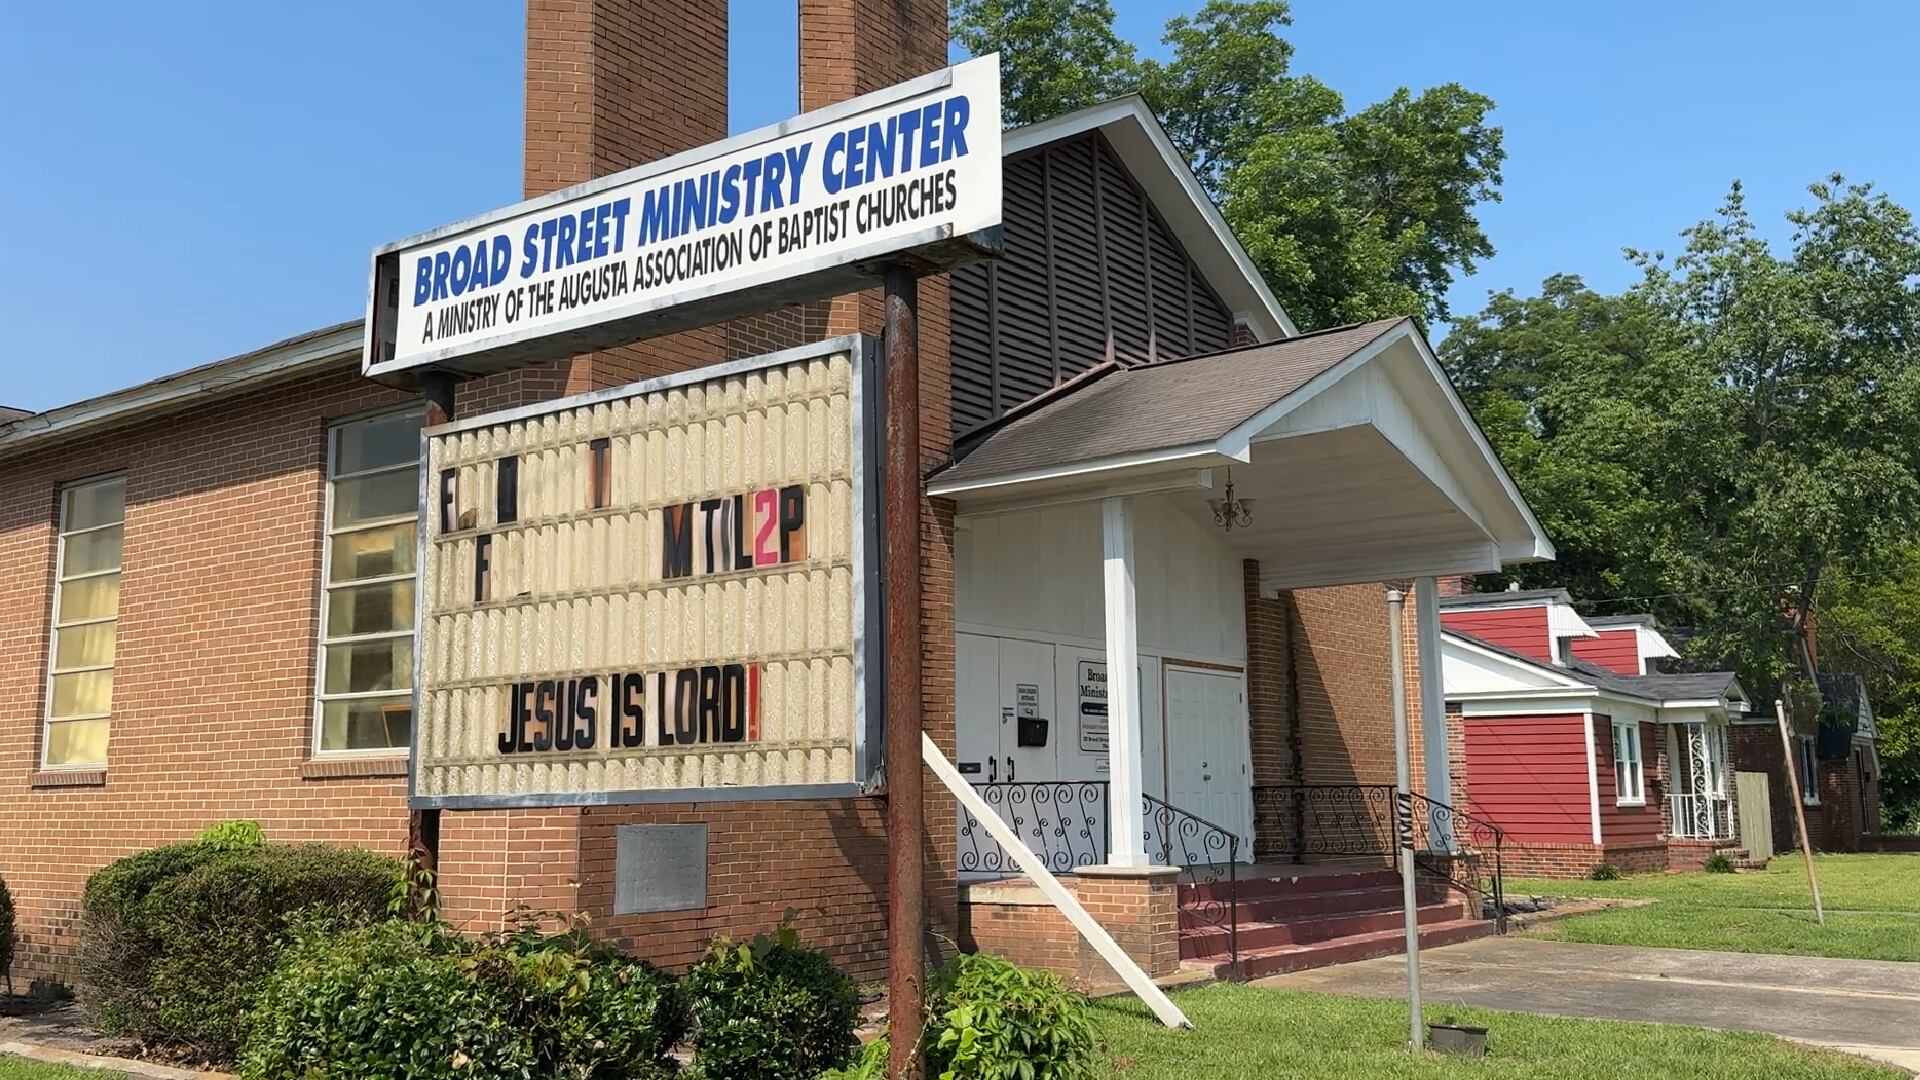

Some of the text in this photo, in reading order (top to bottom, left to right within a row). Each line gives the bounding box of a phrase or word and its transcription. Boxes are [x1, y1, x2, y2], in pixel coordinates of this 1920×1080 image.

[414, 95, 970, 306] BROAD STREET MINISTRY CENTER
[422, 168, 958, 344] A MINISTRY OF THE AUGUSTA ASSOCIATION OF BAPTIST CHURCHES
[589, 437, 610, 509] T
[475, 534, 492, 602] F
[497, 663, 760, 754] JESUS IS LORD!
[1087, 668, 1108, 682] Broa
